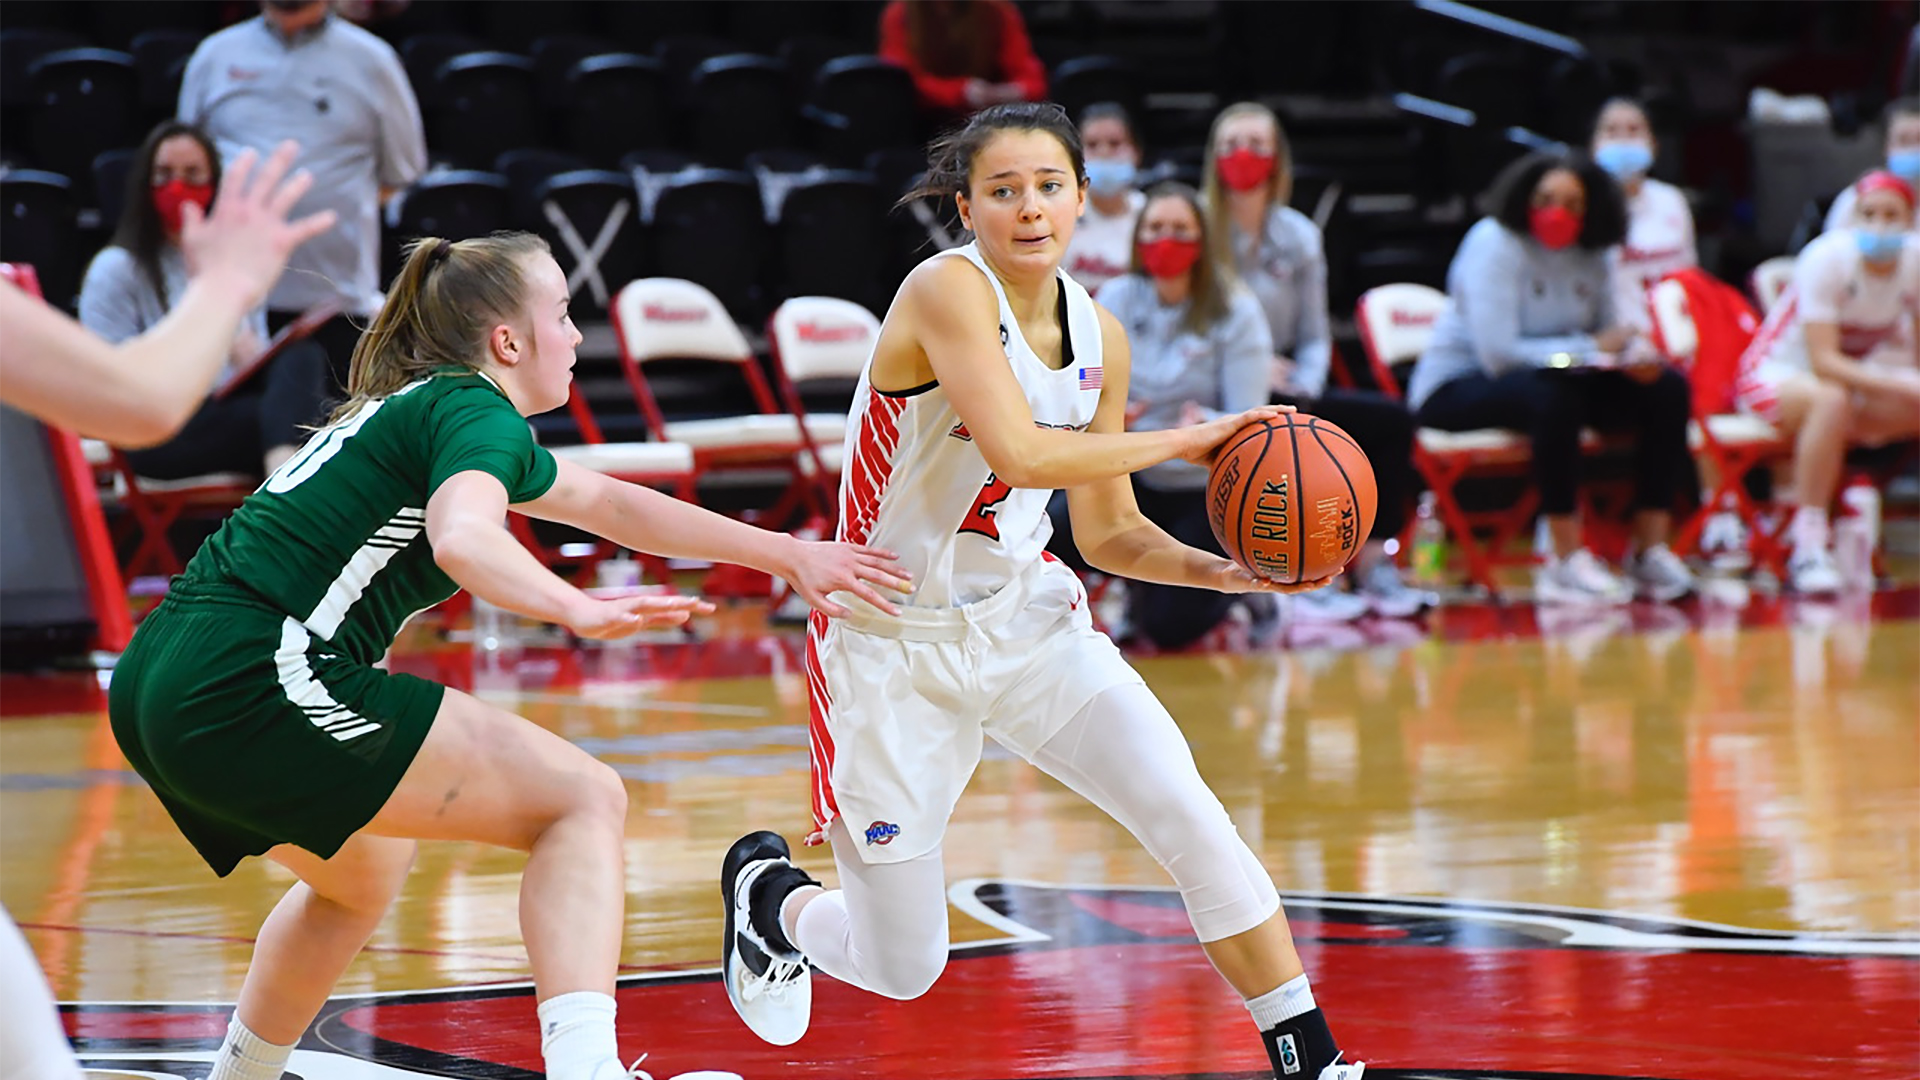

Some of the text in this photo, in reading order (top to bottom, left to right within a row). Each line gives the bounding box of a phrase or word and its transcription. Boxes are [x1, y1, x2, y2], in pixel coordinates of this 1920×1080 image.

[1251, 473, 1290, 578] HE ROCK.
[1340, 504, 1354, 551] ROCK
